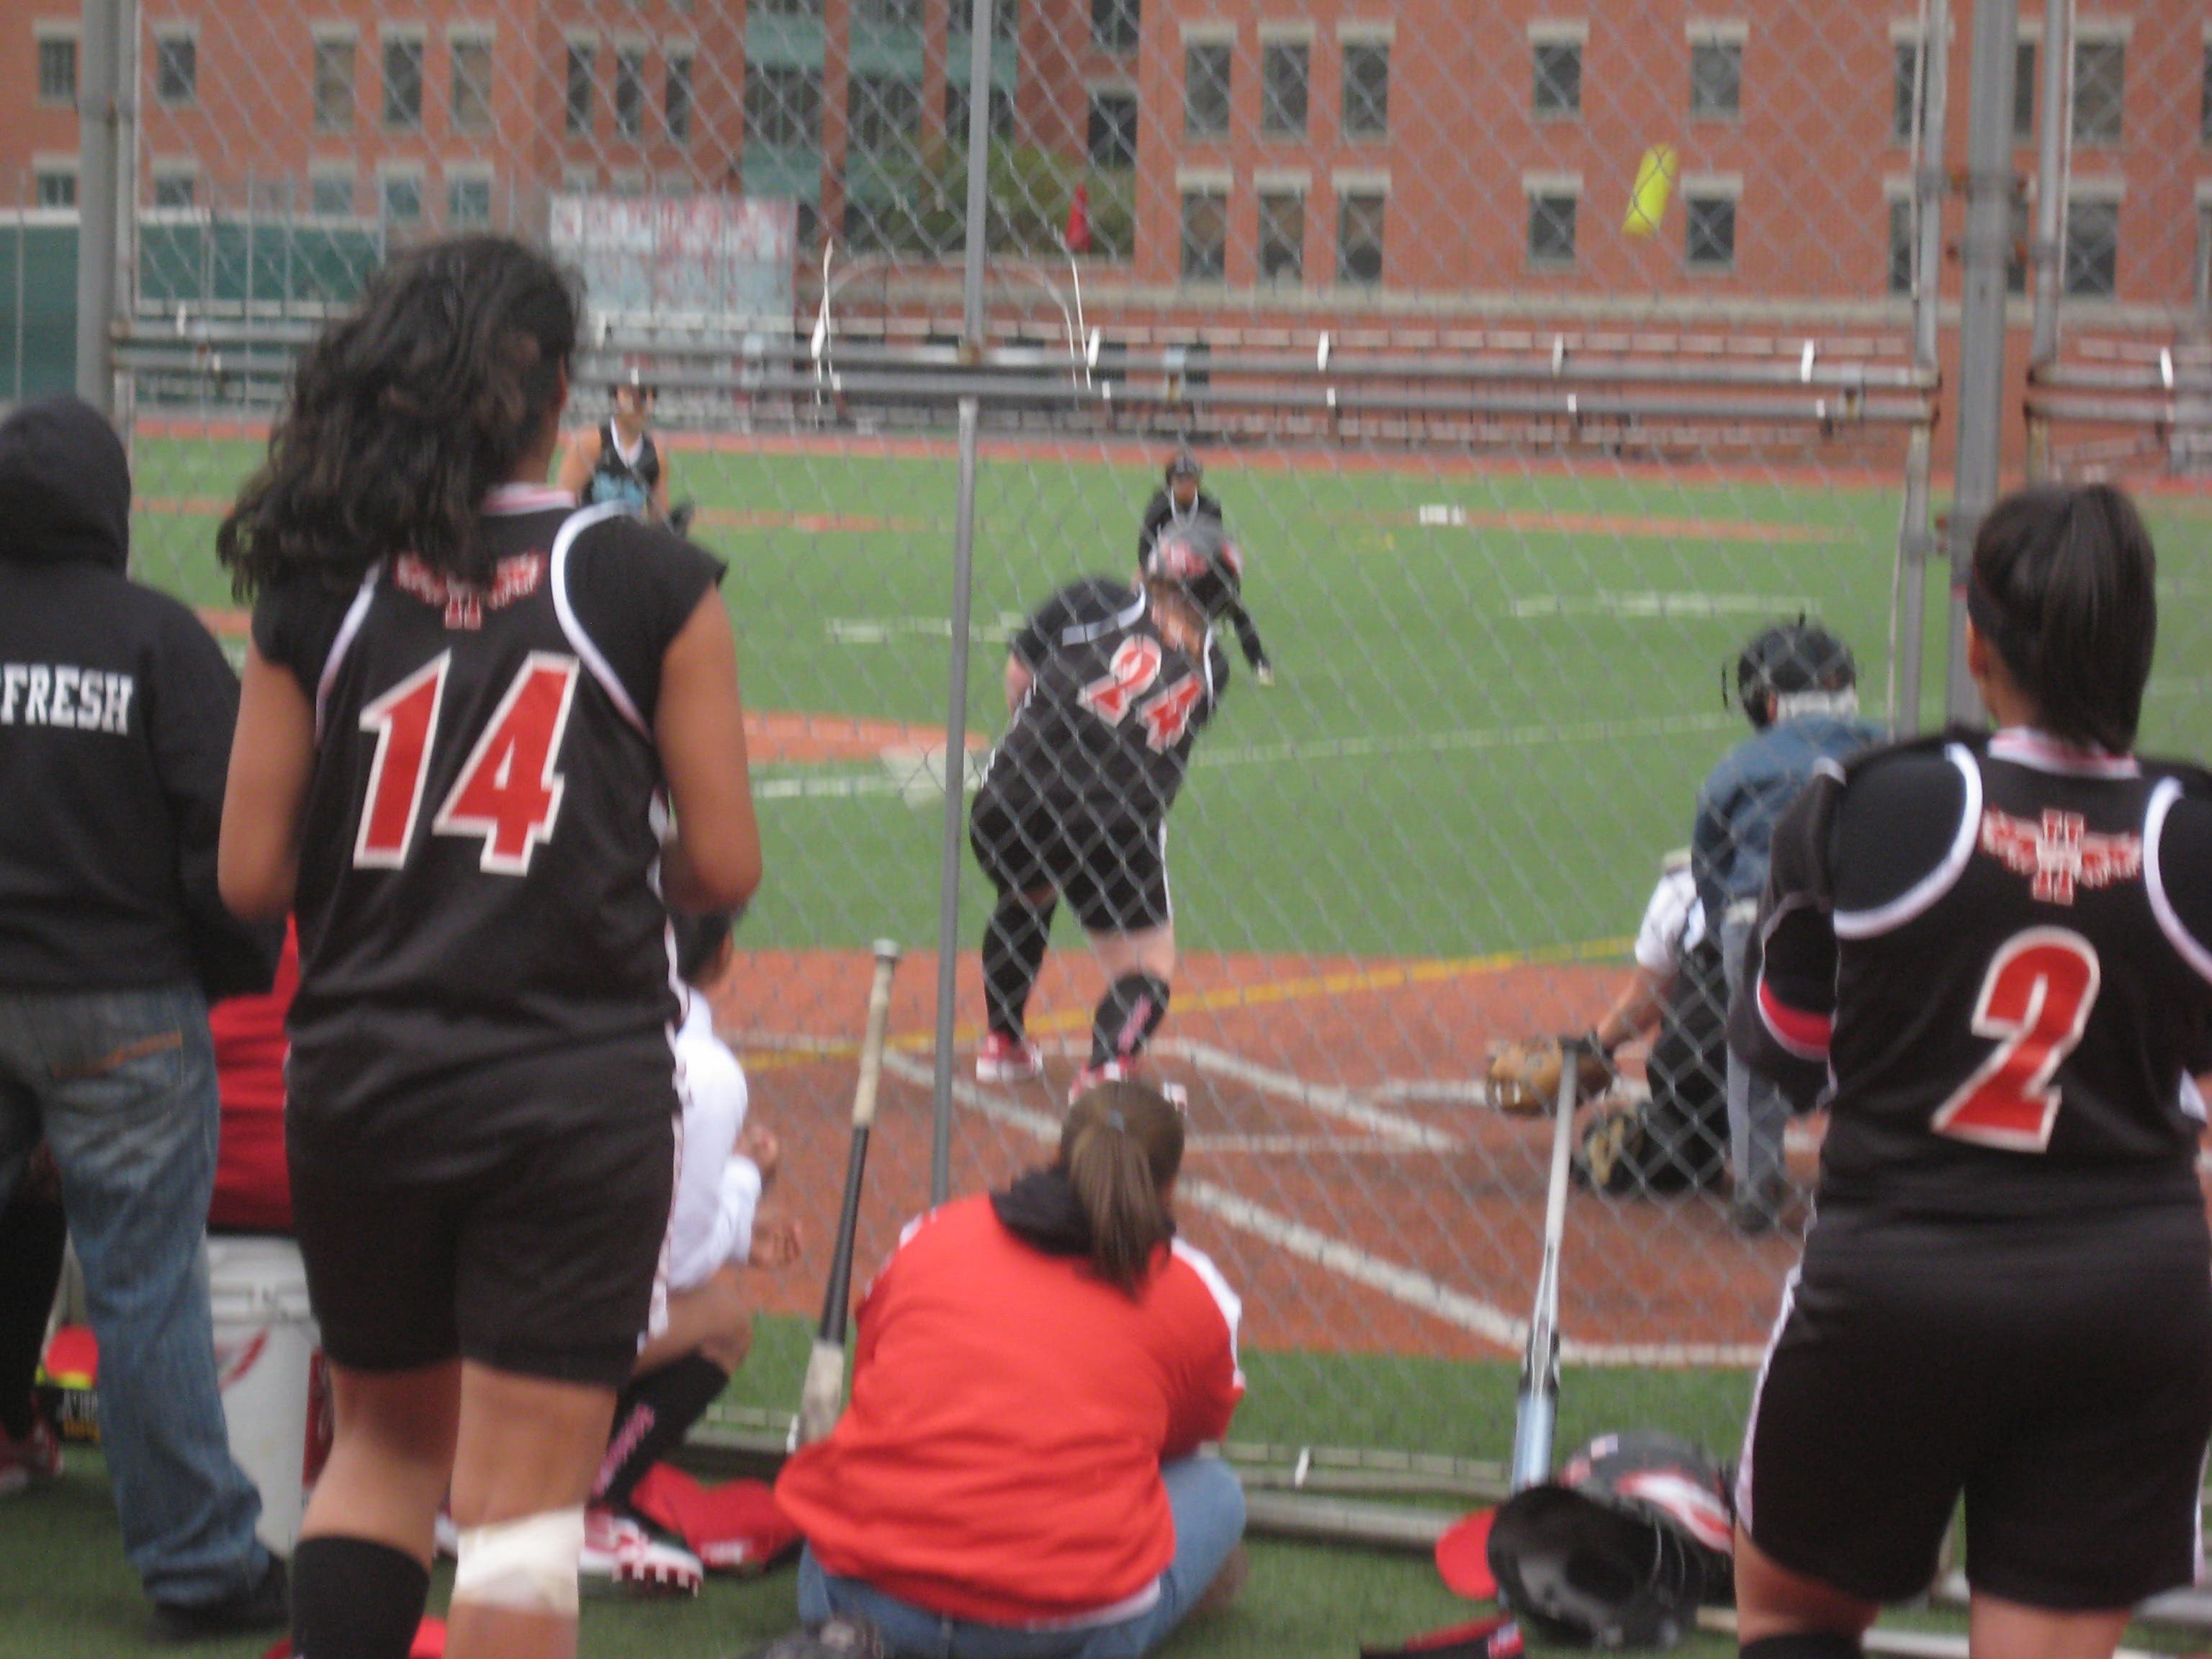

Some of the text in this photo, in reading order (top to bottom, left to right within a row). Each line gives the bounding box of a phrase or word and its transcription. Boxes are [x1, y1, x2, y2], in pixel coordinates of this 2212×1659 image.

[1, 663, 134, 736] FRESH
[353, 647, 580, 876] 14
[1077, 634, 1202, 755] 24
[1931, 925, 2100, 1154] 2
